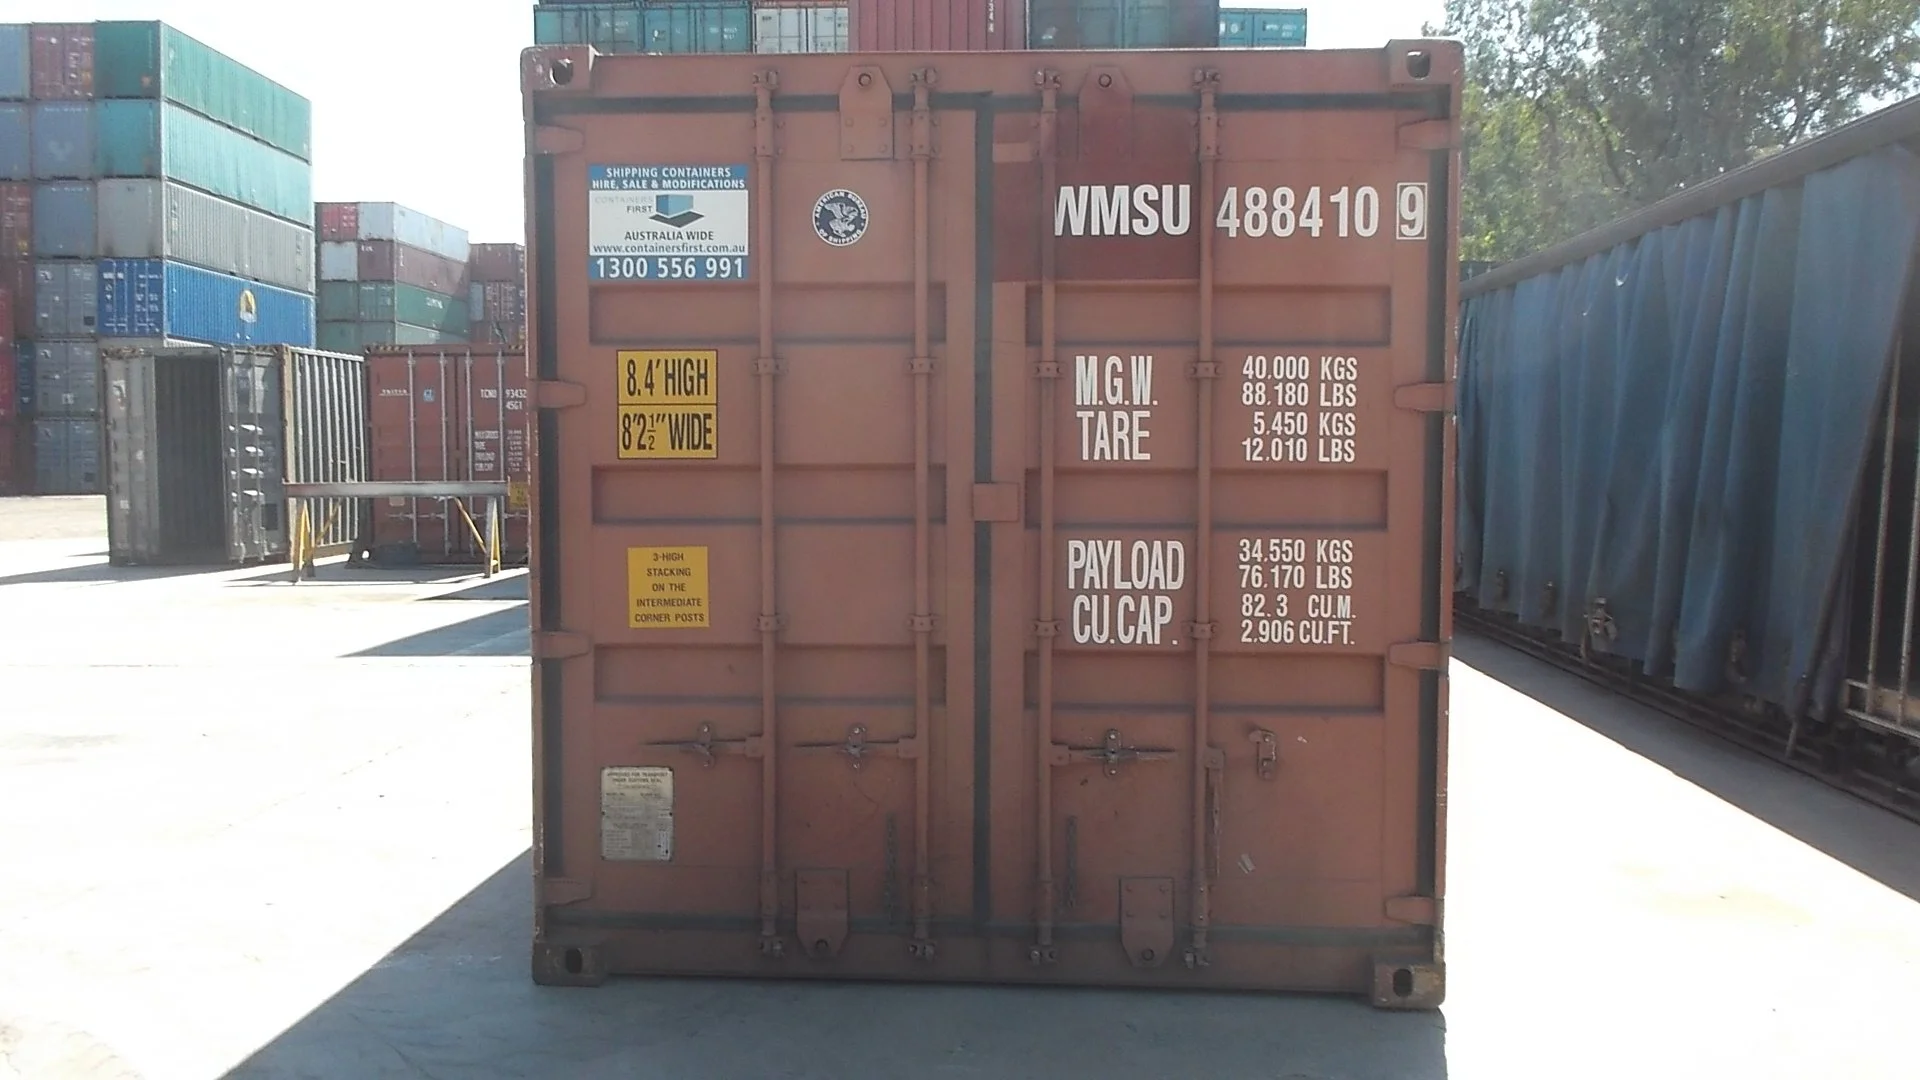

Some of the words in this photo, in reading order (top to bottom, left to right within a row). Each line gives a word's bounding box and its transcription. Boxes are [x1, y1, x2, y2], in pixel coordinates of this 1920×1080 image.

[592, 179, 620, 190] HIRE,
[623, 179, 647, 189] SALE
[651, 179, 659, 189] &
[662, 179, 745, 190] MODIFICATIONS
[606, 167, 658, 178] SHIPPING
[662, 167, 731, 178] CONTAINERS
[626, 205, 653, 213] FIRST
[815, 191, 845, 219] AMERICAN
[1054, 184, 1190, 237] WMSU
[1216, 185, 1379, 238] 488410
[1399, 185, 1425, 237] 9
[593, 242, 745, 254] www.containersfirst.com.au
[624, 231, 684, 241] AUSTRALIA
[686, 231, 714, 241] WIDE
[819, 229, 829, 237] OF
[828, 229, 862, 244] SHIPPING
[596, 257, 648, 278] 1300
[657, 257, 697, 279] 556
[706, 257, 743, 279] 991
[1320, 356, 1358, 380] KGS
[1075, 355, 1158, 406] M.G.W.
[1319, 383, 1357, 407] LBS
[1076, 410, 1151, 460] TARE
[1318, 411, 1356, 436] KGS
[1318, 438, 1355, 462] LBS
[653, 552, 685, 561] 3-HIGH
[1316, 539, 1353, 563] KGS
[646, 567, 691, 577] STACKING
[1067, 540, 1185, 590] PAYLOAD
[1315, 565, 1353, 589] LBS
[652, 583, 665, 592] ON
[669, 583, 687, 592] THE
[636, 598, 702, 607] INTERMEDIATE
[1307, 594, 1357, 619] CU.M.
[634, 613, 671, 622] CORNER
[674, 613, 705, 622] POSTS
[1298, 620, 1355, 645] CU.FT.
